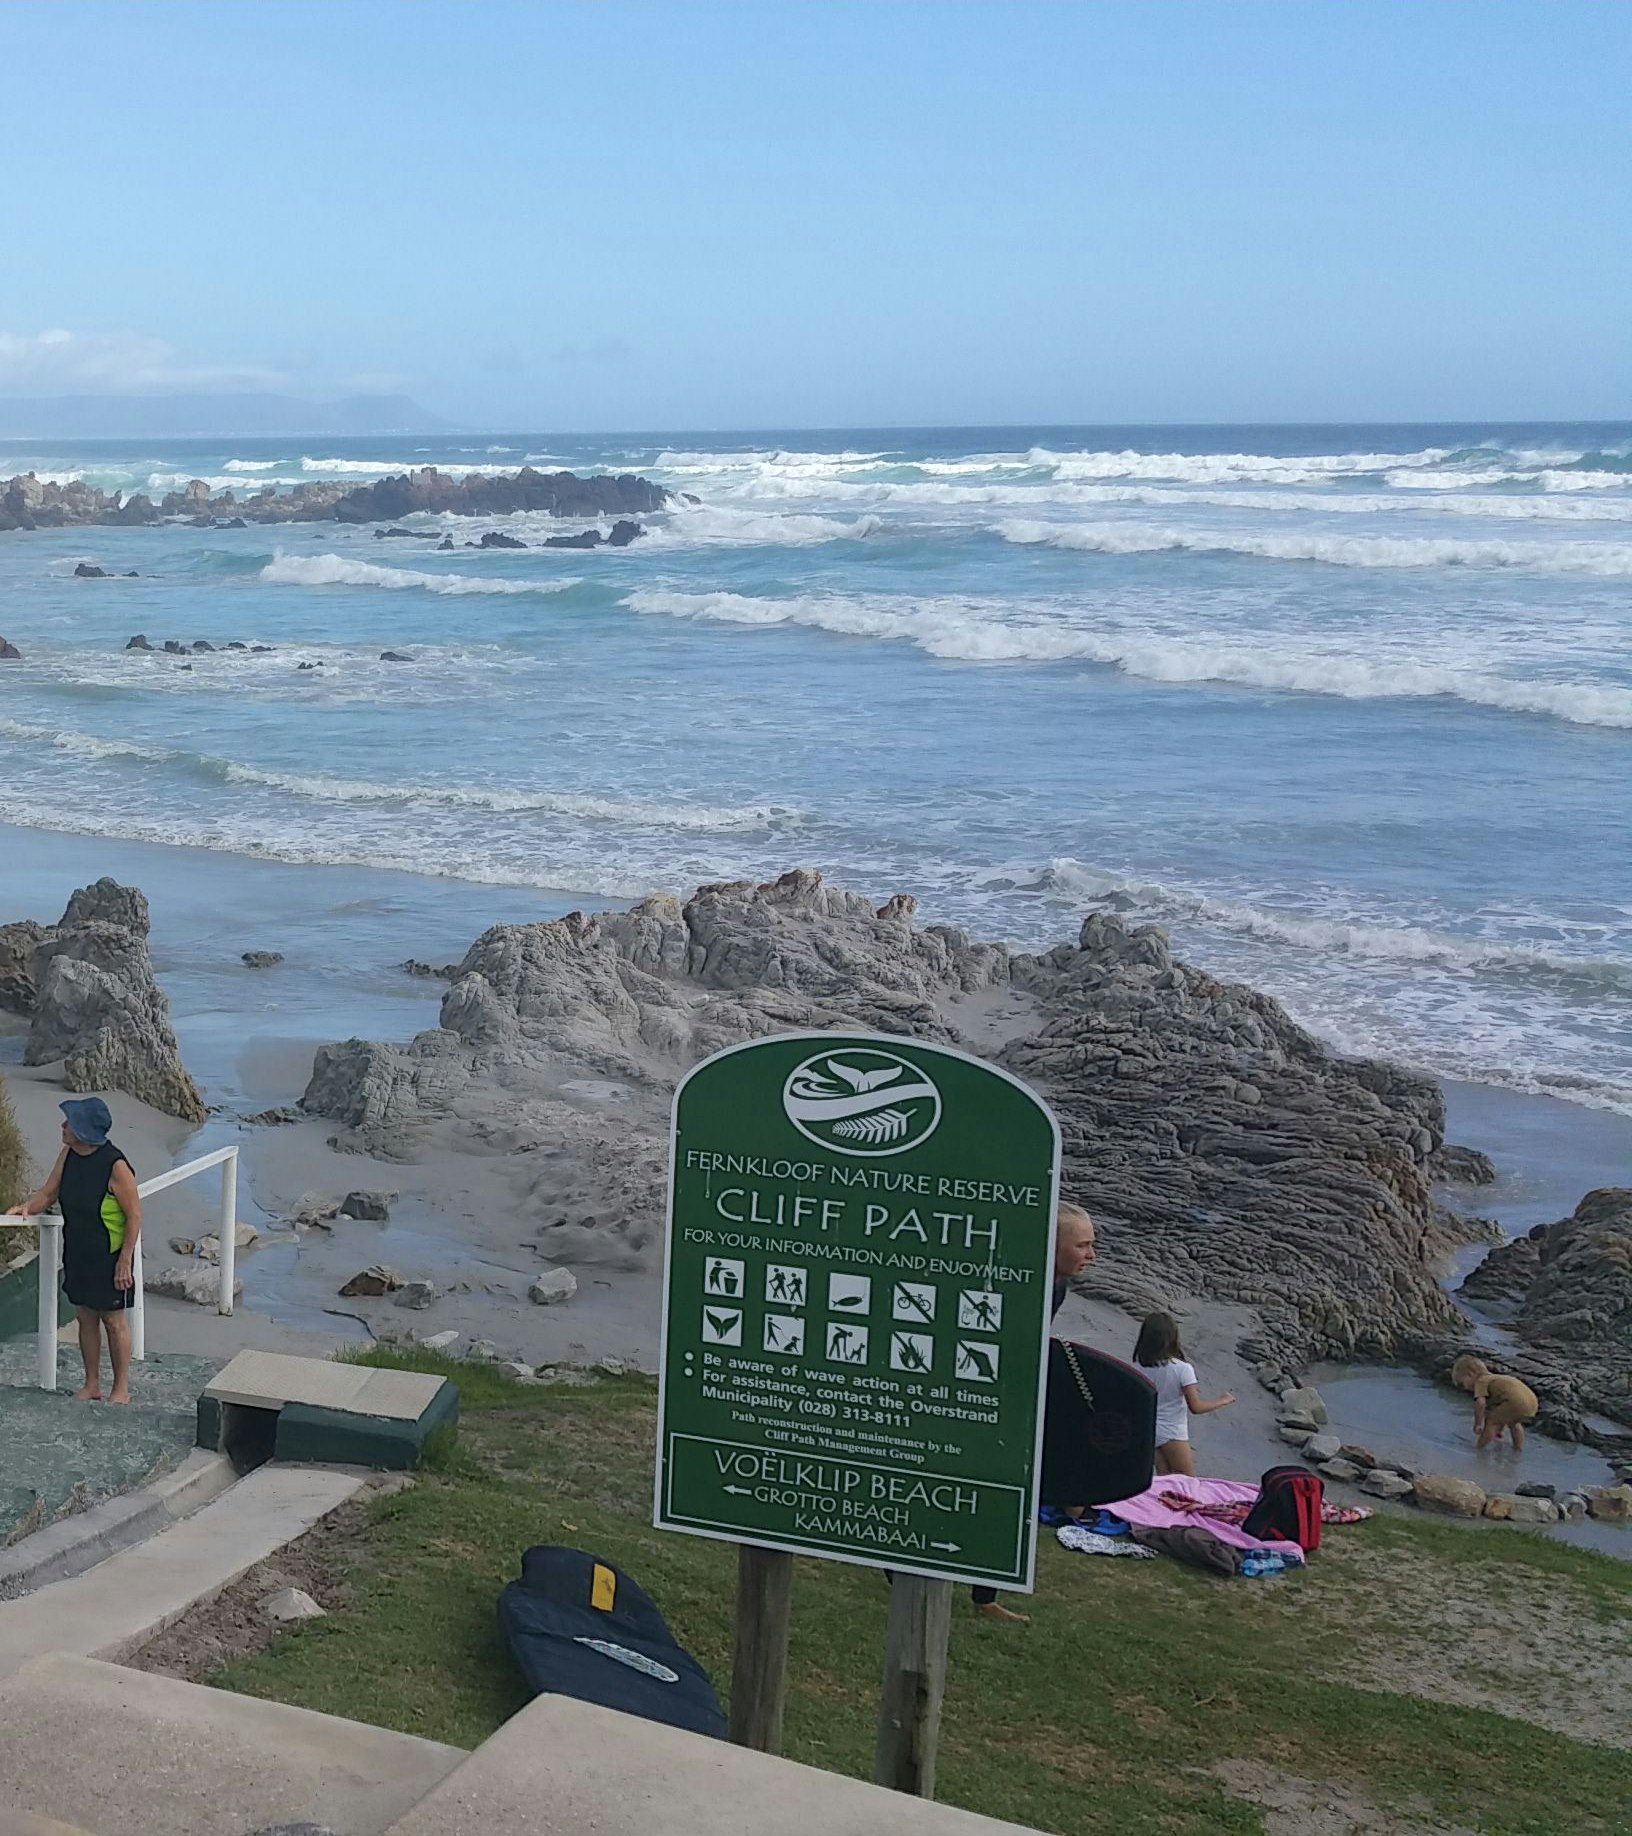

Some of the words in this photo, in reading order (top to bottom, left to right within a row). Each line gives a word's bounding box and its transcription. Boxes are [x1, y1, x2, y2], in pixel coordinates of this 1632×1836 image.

[686, 1150, 825, 1182] FERNKLOOF
[830, 1166, 931, 1194] NATURE
[937, 1177, 1040, 1207] RESERVE
[716, 1188, 846, 1230] CLIFF
[864, 1204, 998, 1250] PATH
[684, 1228, 715, 1244] FOR
[718, 1231, 762, 1250] YOUR
[765, 1238, 884, 1265] INFORMATION
[886, 1253, 926, 1270] AND
[930, 1258, 1034, 1283] ENJOYMENT
[702, 1385, 792, 1412] Municipality
[799, 1399, 837, 1418] (028)
[842, 1406, 910, 1427] 313-8111
[703, 1352, 721, 1366] Be
[728, 1358, 774, 1374] aware
[781, 1364, 798, 1377] of
[804, 1369, 845, 1384] wave
[852, 1375, 899, 1392] action
[907, 1384, 923, 1396] at
[930, 1386, 948, 1399] all
[956, 1389, 999, 1407] times
[703, 1369, 726, 1383] For
[732, 1375, 810, 1397] assistance,
[816, 1386, 872, 1405] contact
[878, 1395, 904, 1410] the
[910, 1400, 998, 1424] Overstrand
[732, 1410, 756, 1422] Path
[758, 1416, 833, 1434] reconstruction
[835, 1427, 855, 1439] and
[857, 1431, 925, 1449] maintenance
[928, 1440, 941, 1453] by
[944, 1443, 962, 1455] the
[765, 1429, 789, 1441] Cliff
[791, 1433, 816, 1445] Path
[818, 1437, 886, 1457] Management
[889, 1449, 925, 1464] Group
[714, 1450, 861, 1494] VOËLKLIP
[870, 1474, 978, 1515] BEACH
[754, 1486, 837, 1513] GROTTO
[842, 1499, 910, 1526] BEACH
[794, 1512, 927, 1550] KAMMABAAI
